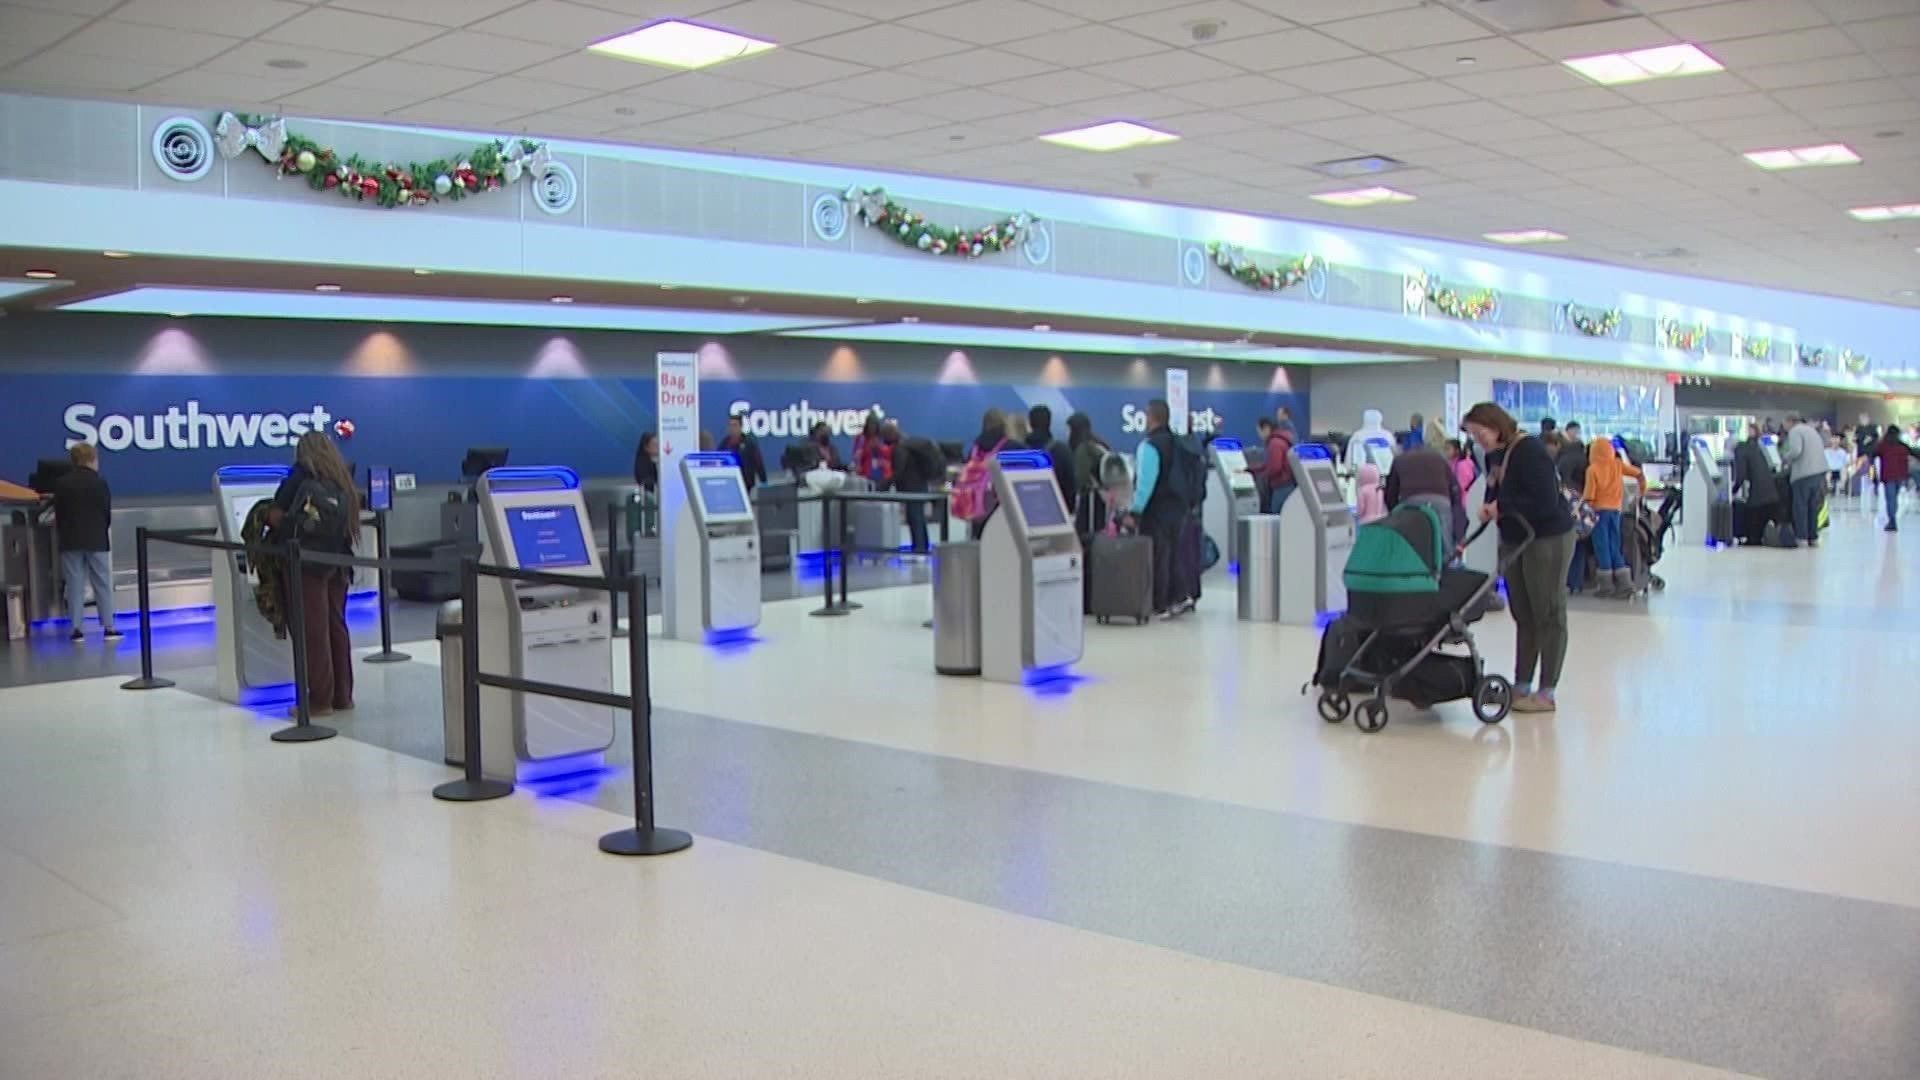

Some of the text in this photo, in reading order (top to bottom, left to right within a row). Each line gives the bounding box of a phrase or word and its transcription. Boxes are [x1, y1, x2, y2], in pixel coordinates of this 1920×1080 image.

[661, 372, 685, 389] Bag
[662, 391, 695, 408] Drop
[64, 401, 331, 450] Southwest
[1121, 404, 1215, 434] Soest
